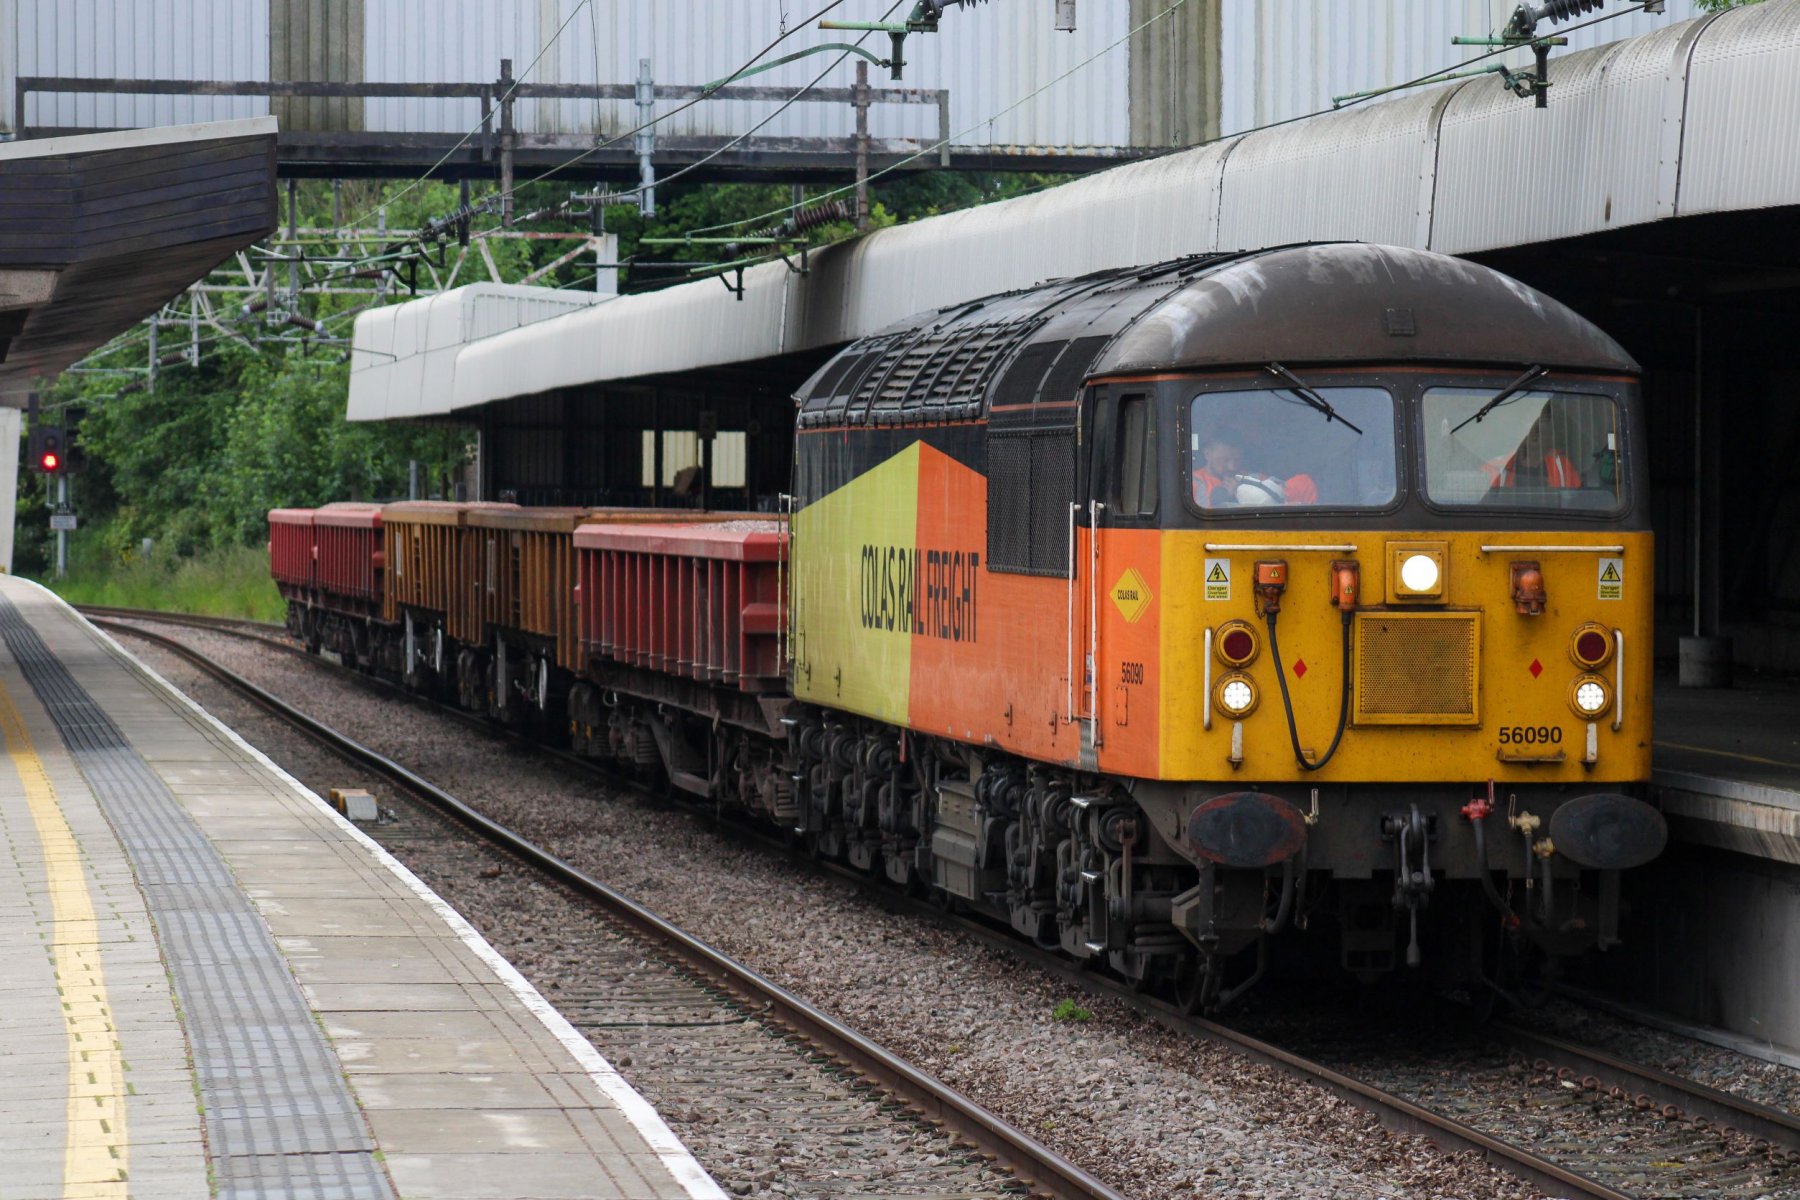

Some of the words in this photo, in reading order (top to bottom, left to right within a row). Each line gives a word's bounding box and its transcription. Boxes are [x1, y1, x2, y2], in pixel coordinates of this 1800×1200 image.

[861, 544, 895, 632] COLAS
[899, 547, 924, 635] RAIL
[927, 549, 979, 643] FREIGHT
[1117, 589, 1129, 600] COLAS
[1130, 590, 1138, 600] RAIL
[1121, 661, 1144, 685] 56090
[1498, 726, 1562, 744] 56090
